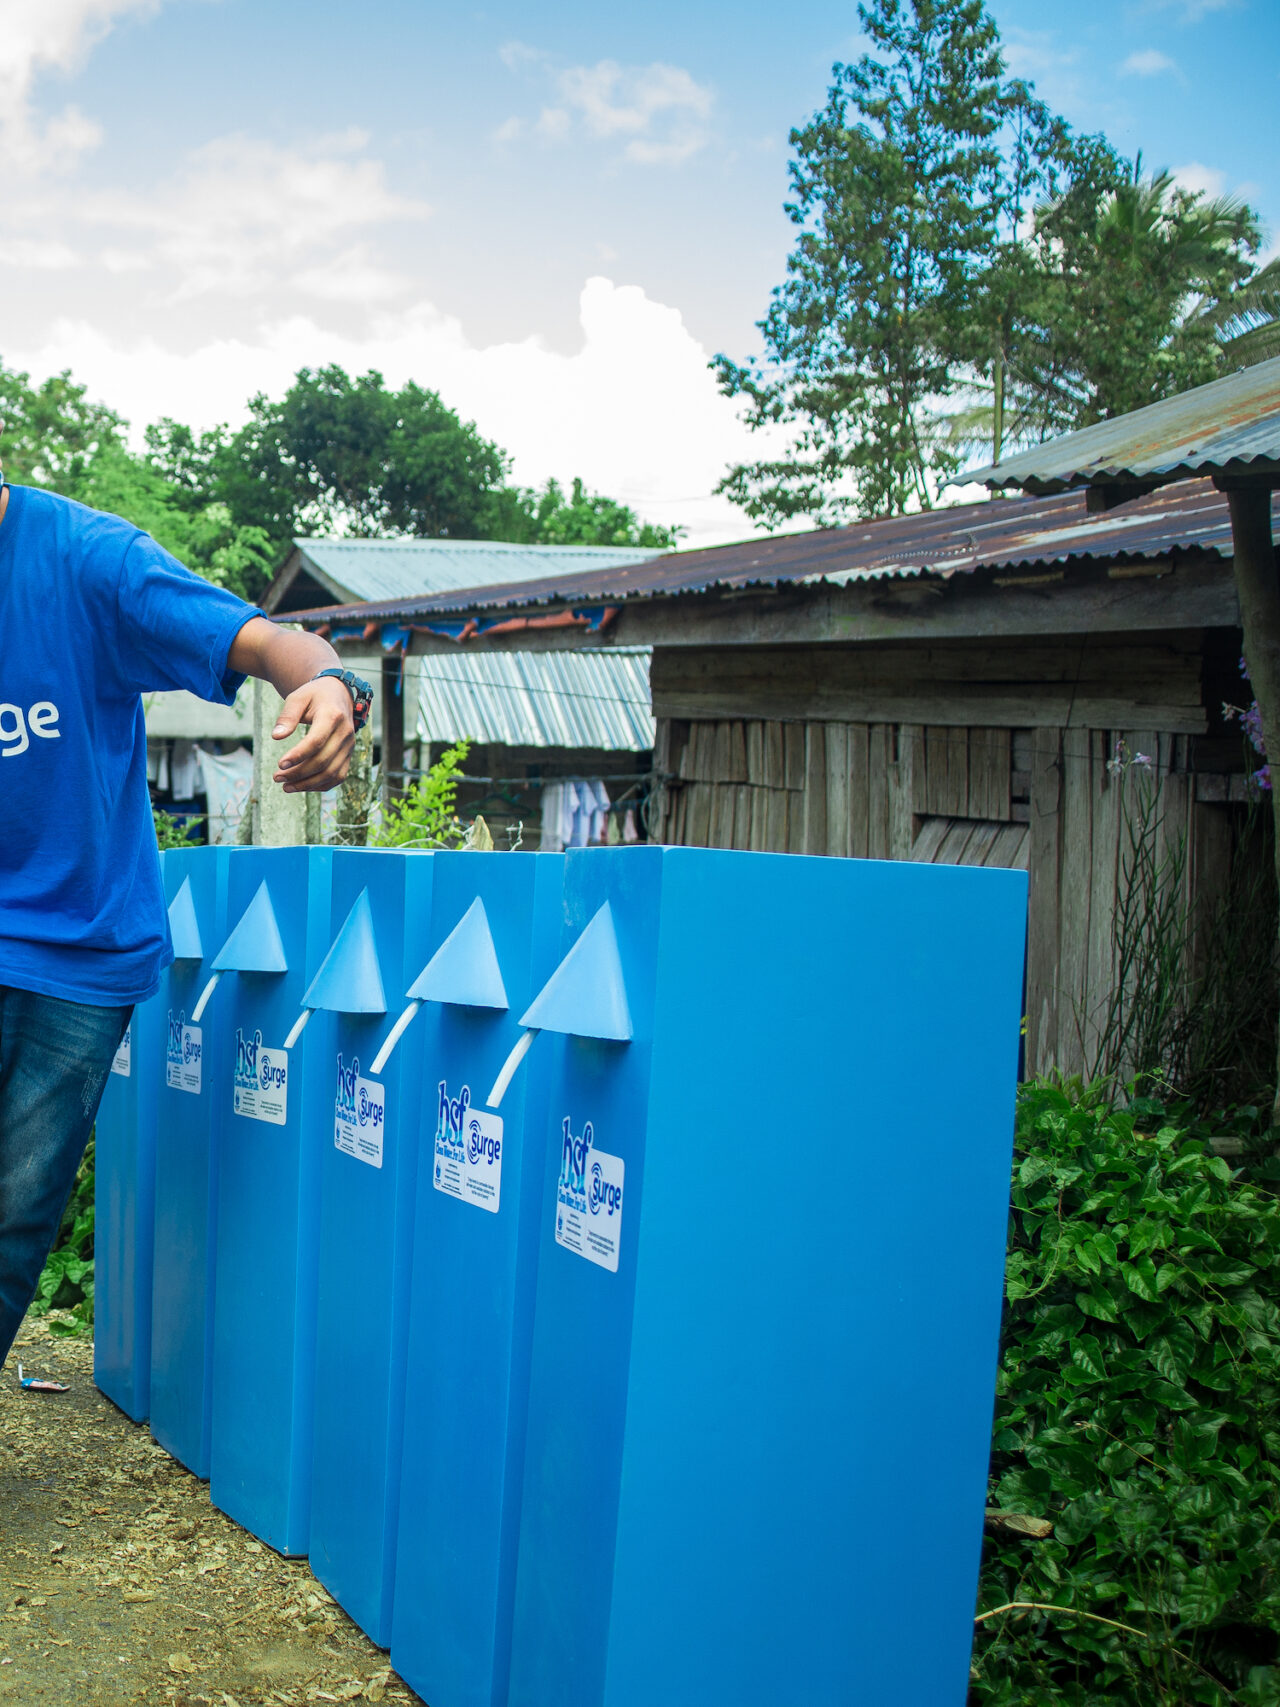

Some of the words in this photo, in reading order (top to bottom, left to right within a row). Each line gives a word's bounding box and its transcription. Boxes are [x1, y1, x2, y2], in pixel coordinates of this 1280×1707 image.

[263, 1065, 286, 1089] surge
[361, 1098, 384, 1127] surge
[471, 1131, 501, 1165] surge
[593, 1177, 622, 1216] surge
